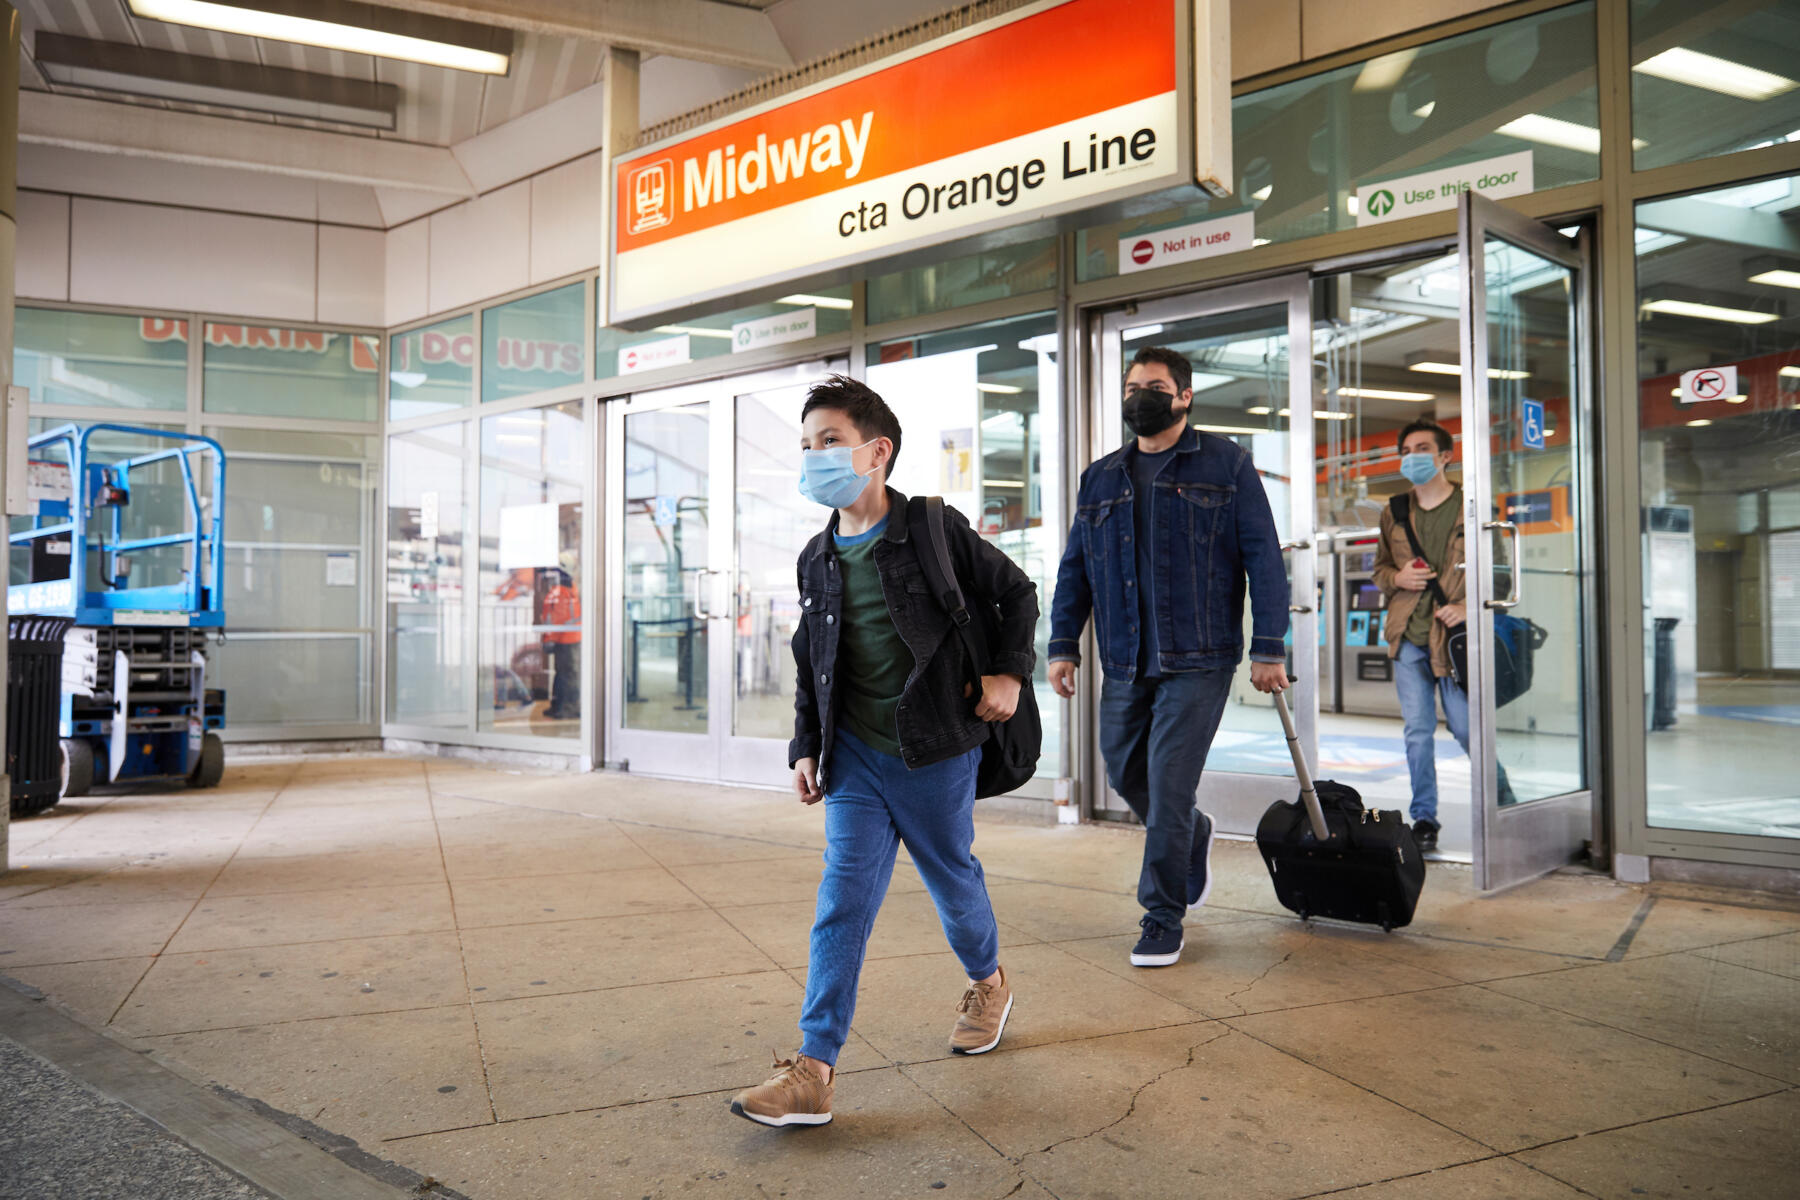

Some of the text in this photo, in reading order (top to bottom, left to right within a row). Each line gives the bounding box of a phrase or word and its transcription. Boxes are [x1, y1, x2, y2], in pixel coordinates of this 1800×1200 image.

[684, 111, 874, 212] Midway
[839, 128, 1156, 237] cta Orange Line
[1404, 171, 1518, 205] Use this door
[1163, 231, 1231, 253] Not in use
